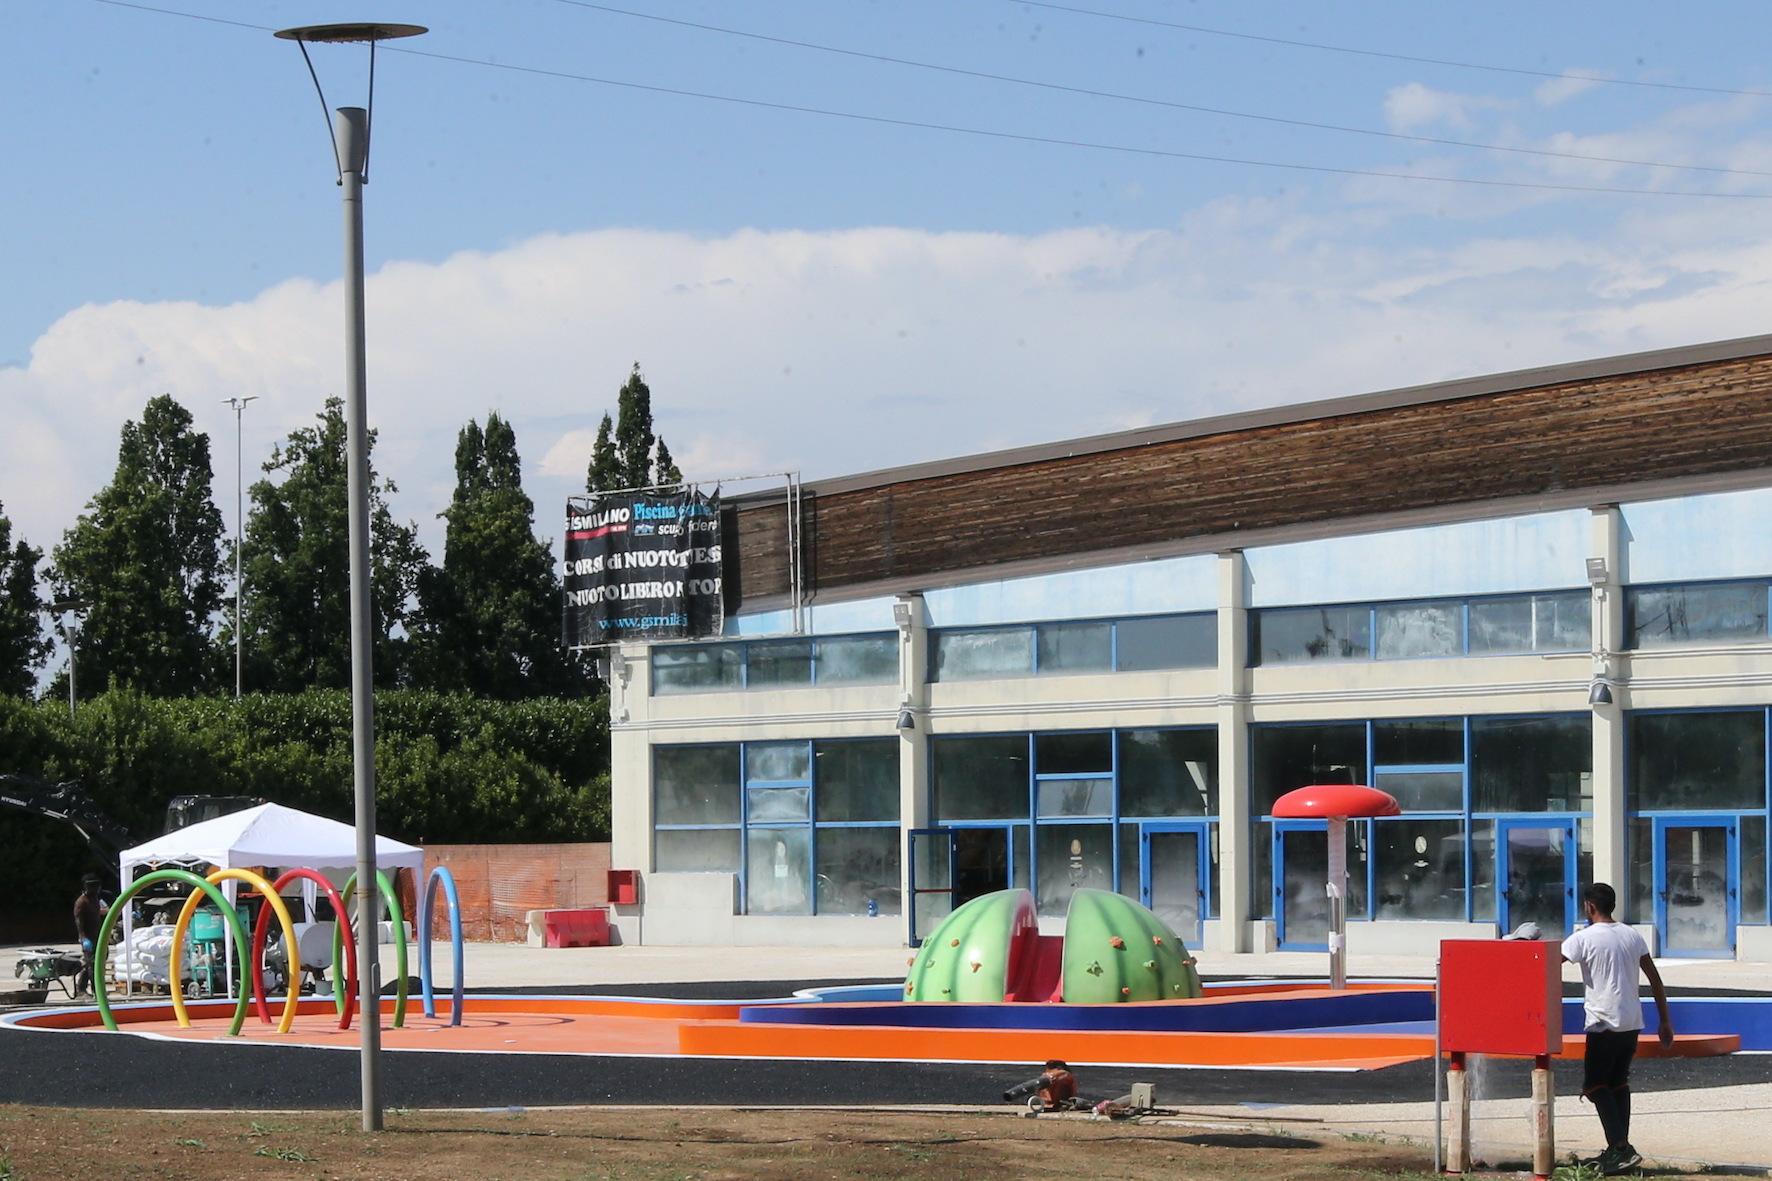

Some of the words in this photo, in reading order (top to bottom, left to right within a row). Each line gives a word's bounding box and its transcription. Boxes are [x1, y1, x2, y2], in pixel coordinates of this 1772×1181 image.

[633, 502, 676, 520] Piscina
[607, 553, 622, 569] di
[567, 585, 619, 607] NUOTO
[620, 581, 675, 600] LIBERO
